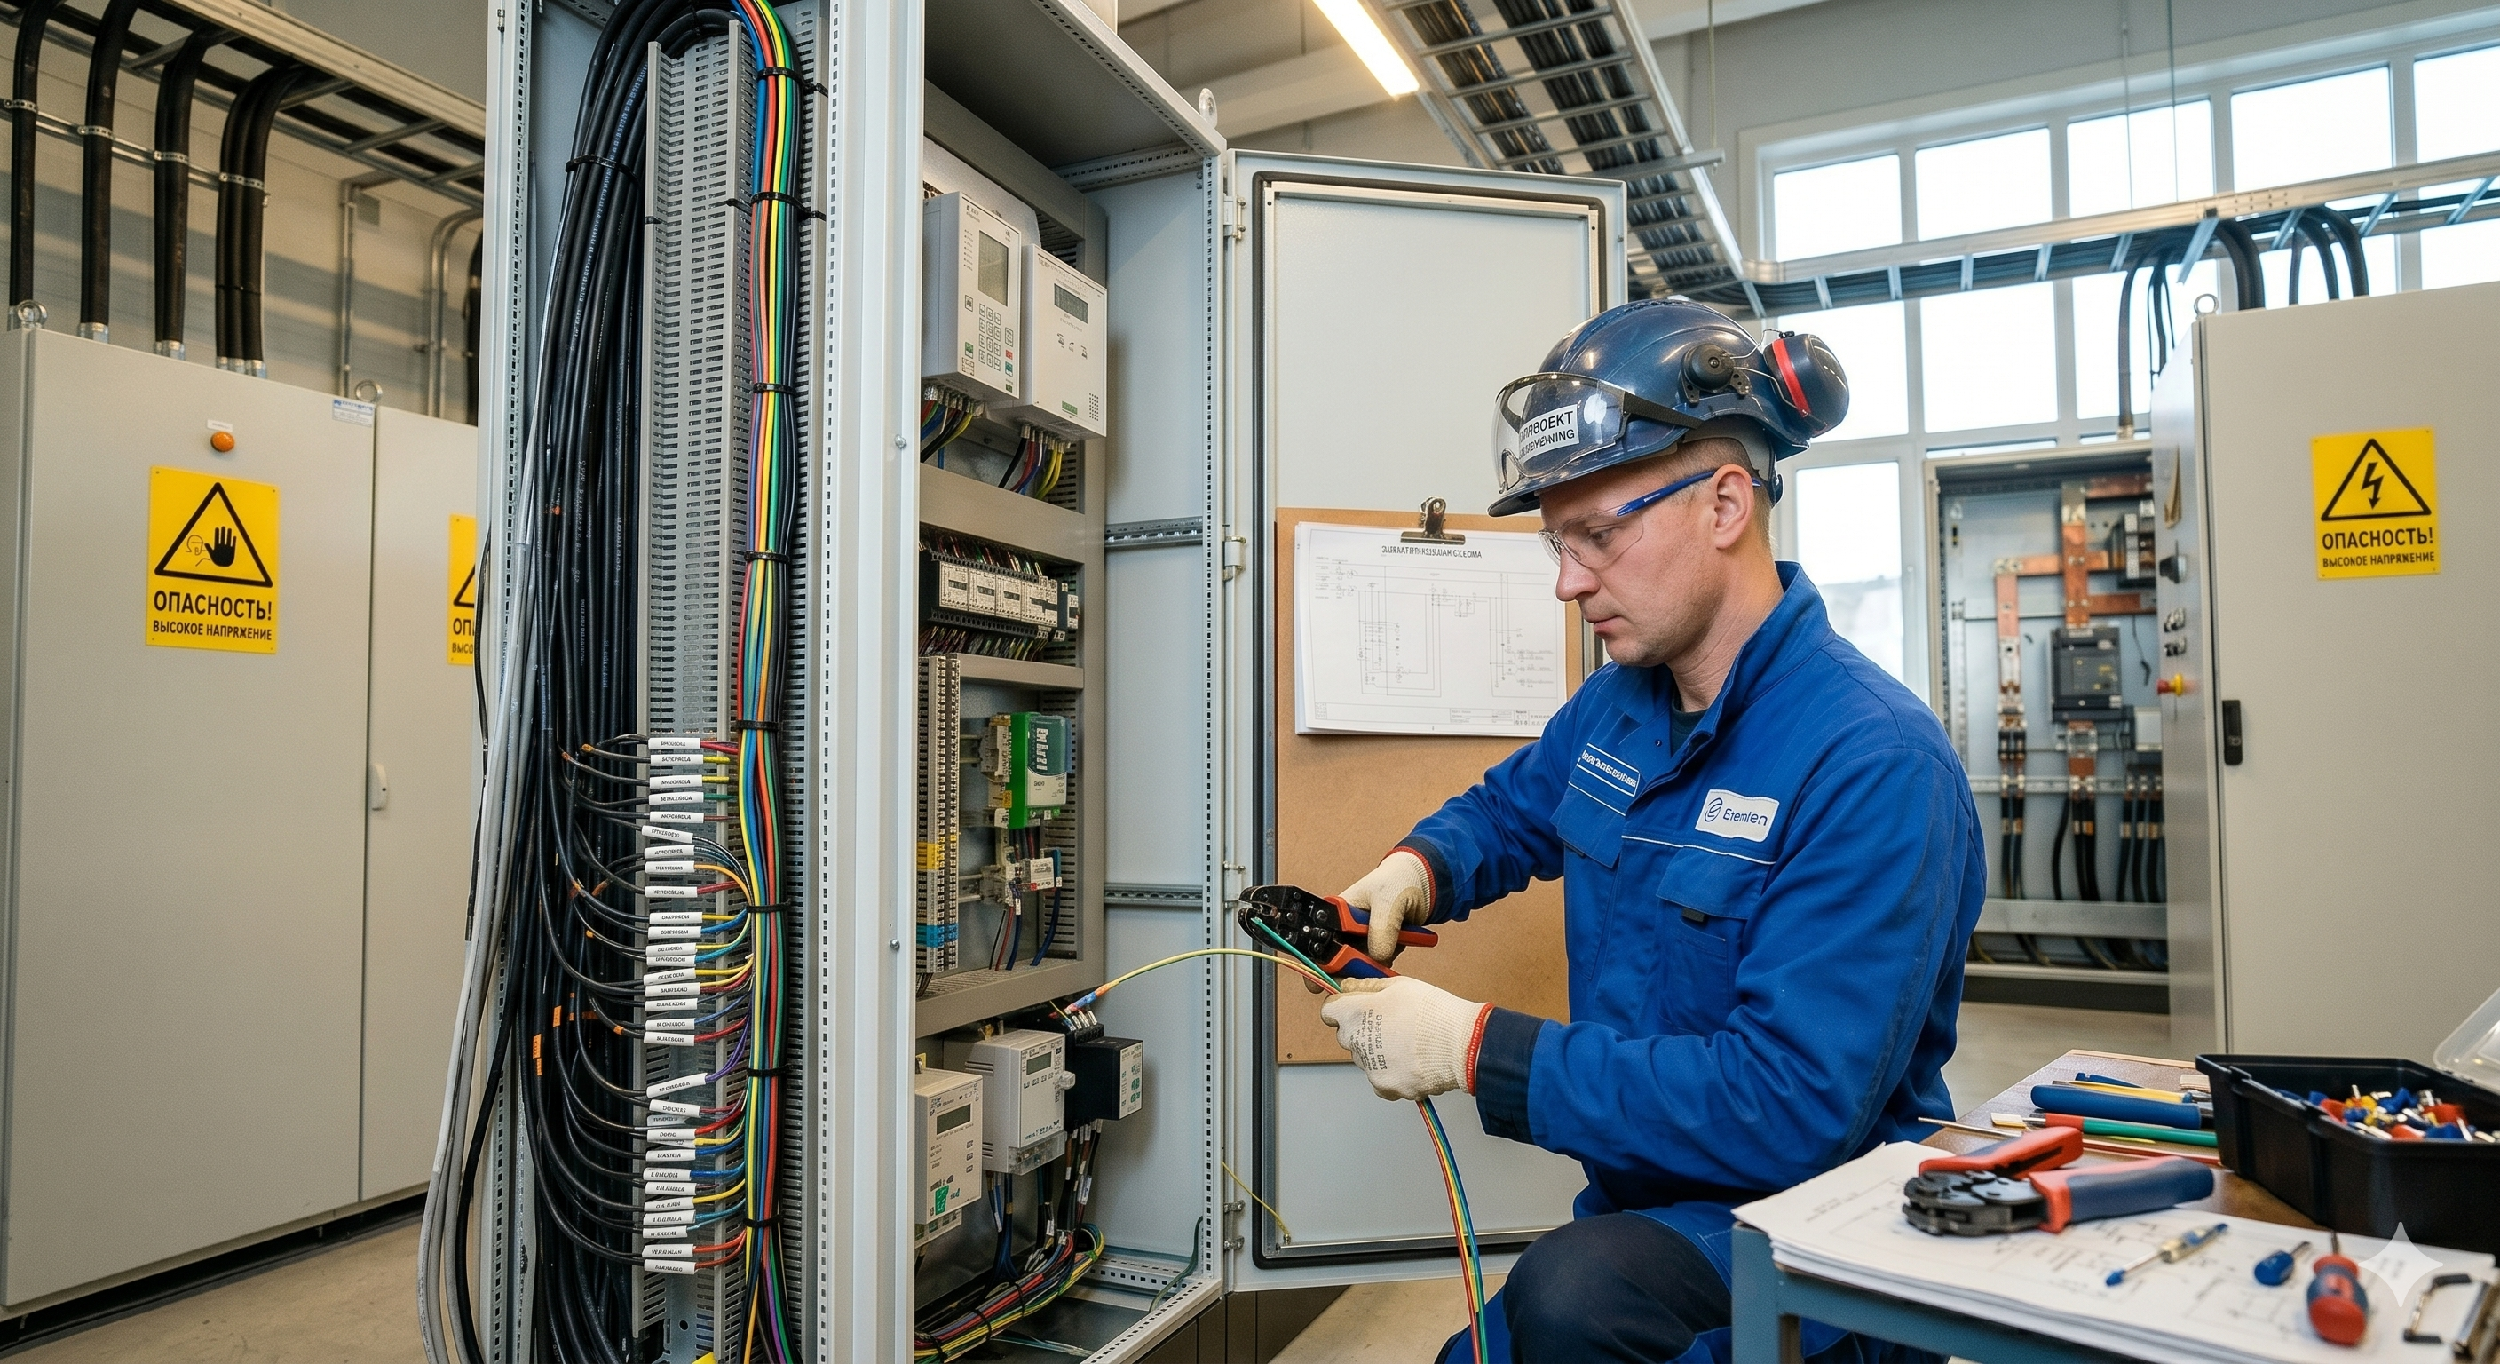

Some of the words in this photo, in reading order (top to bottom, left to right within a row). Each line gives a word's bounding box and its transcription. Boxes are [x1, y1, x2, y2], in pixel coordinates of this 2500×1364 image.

[2321, 527, 2434, 550] ОПАСНОСТЬ!
[153, 590, 272, 621] ОПАСНОСТЬ!
[153, 619, 203, 636] ВЫСОКОЕ
[453, 617, 475, 637] ОП
